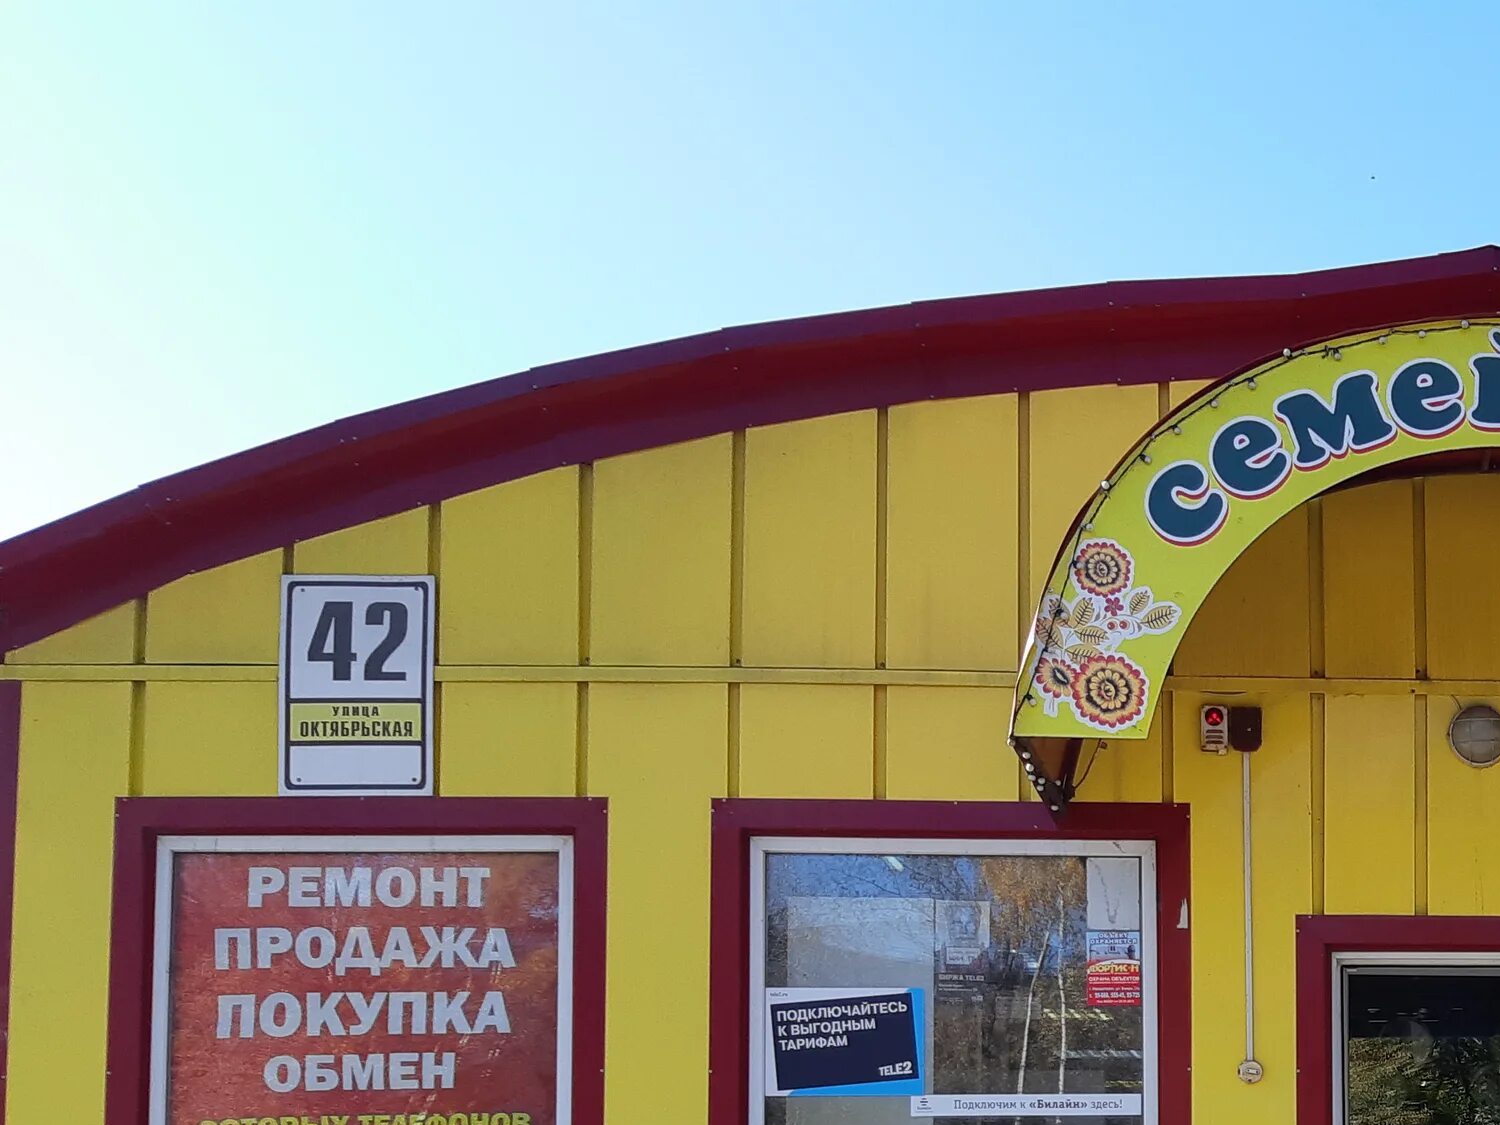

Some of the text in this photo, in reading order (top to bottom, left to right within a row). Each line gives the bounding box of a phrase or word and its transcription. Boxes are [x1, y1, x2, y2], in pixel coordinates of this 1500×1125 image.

[307, 601, 408, 681] 42
[332, 706, 379, 717] УЛИЦА
[300, 721, 413, 737] ОКТЯБРЬСКАЯ
[247, 866, 491, 908] РЕМОНТ
[214, 926, 517, 976] ПРОДАЖА
[216, 991, 512, 1039] ПОКУПКА
[776, 1001, 908, 1022] ПОДКЛЮЧАЙТЕСЬ
[778, 1018, 876, 1037] К ВЫГОДНЫМ
[778, 1035, 848, 1051] ТАРИФАМ
[263, 1052, 456, 1093] ОБМЕН
[878, 1061, 913, 1076] TELE2
[953, 1099, 1017, 1111] Подключим
[1029, 1098, 1088, 1109] «Билайн»
[1090, 1099, 1124, 1110] здесь!
